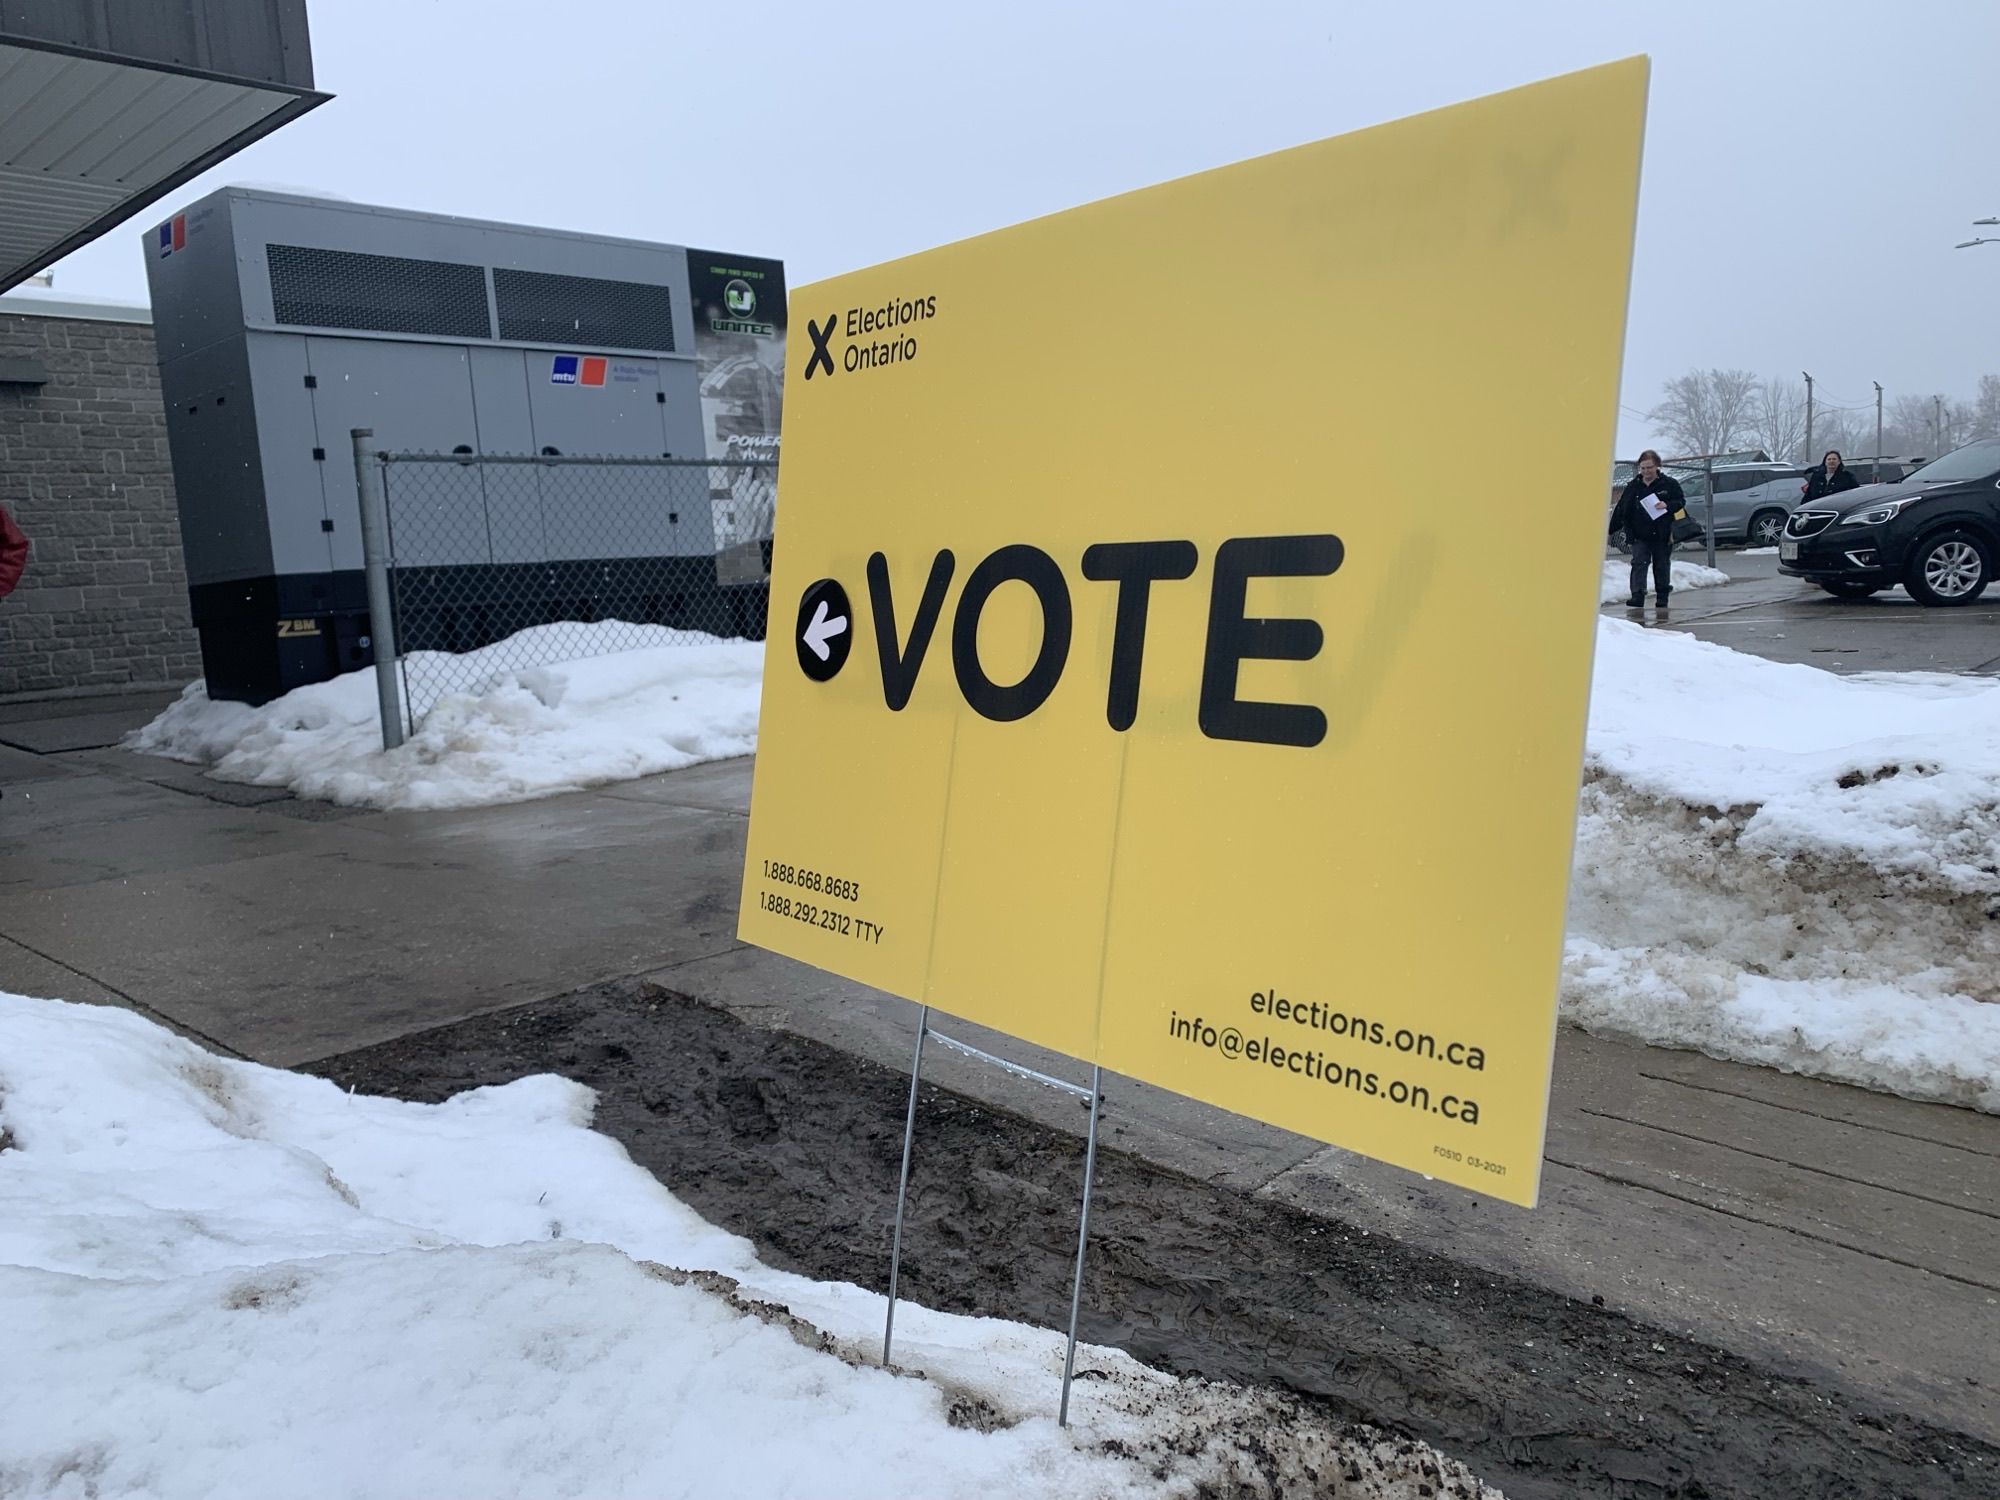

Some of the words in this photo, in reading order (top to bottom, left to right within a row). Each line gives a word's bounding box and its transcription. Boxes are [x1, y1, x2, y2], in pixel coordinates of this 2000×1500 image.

[846, 295, 937, 338] Elections
[844, 332, 917, 373] Ontario
[552, 372, 576, 382] mtu
[866, 534, 1345, 748] VOTE
[763, 859, 860, 902] 1.888.668.8683
[760, 891, 851, 936] 1.888.292.2312
[855, 918, 884, 945] TTY
[1250, 989, 1486, 1071] elections.on.ca
[1169, 1011, 1480, 1125] info@elections.on.ca
